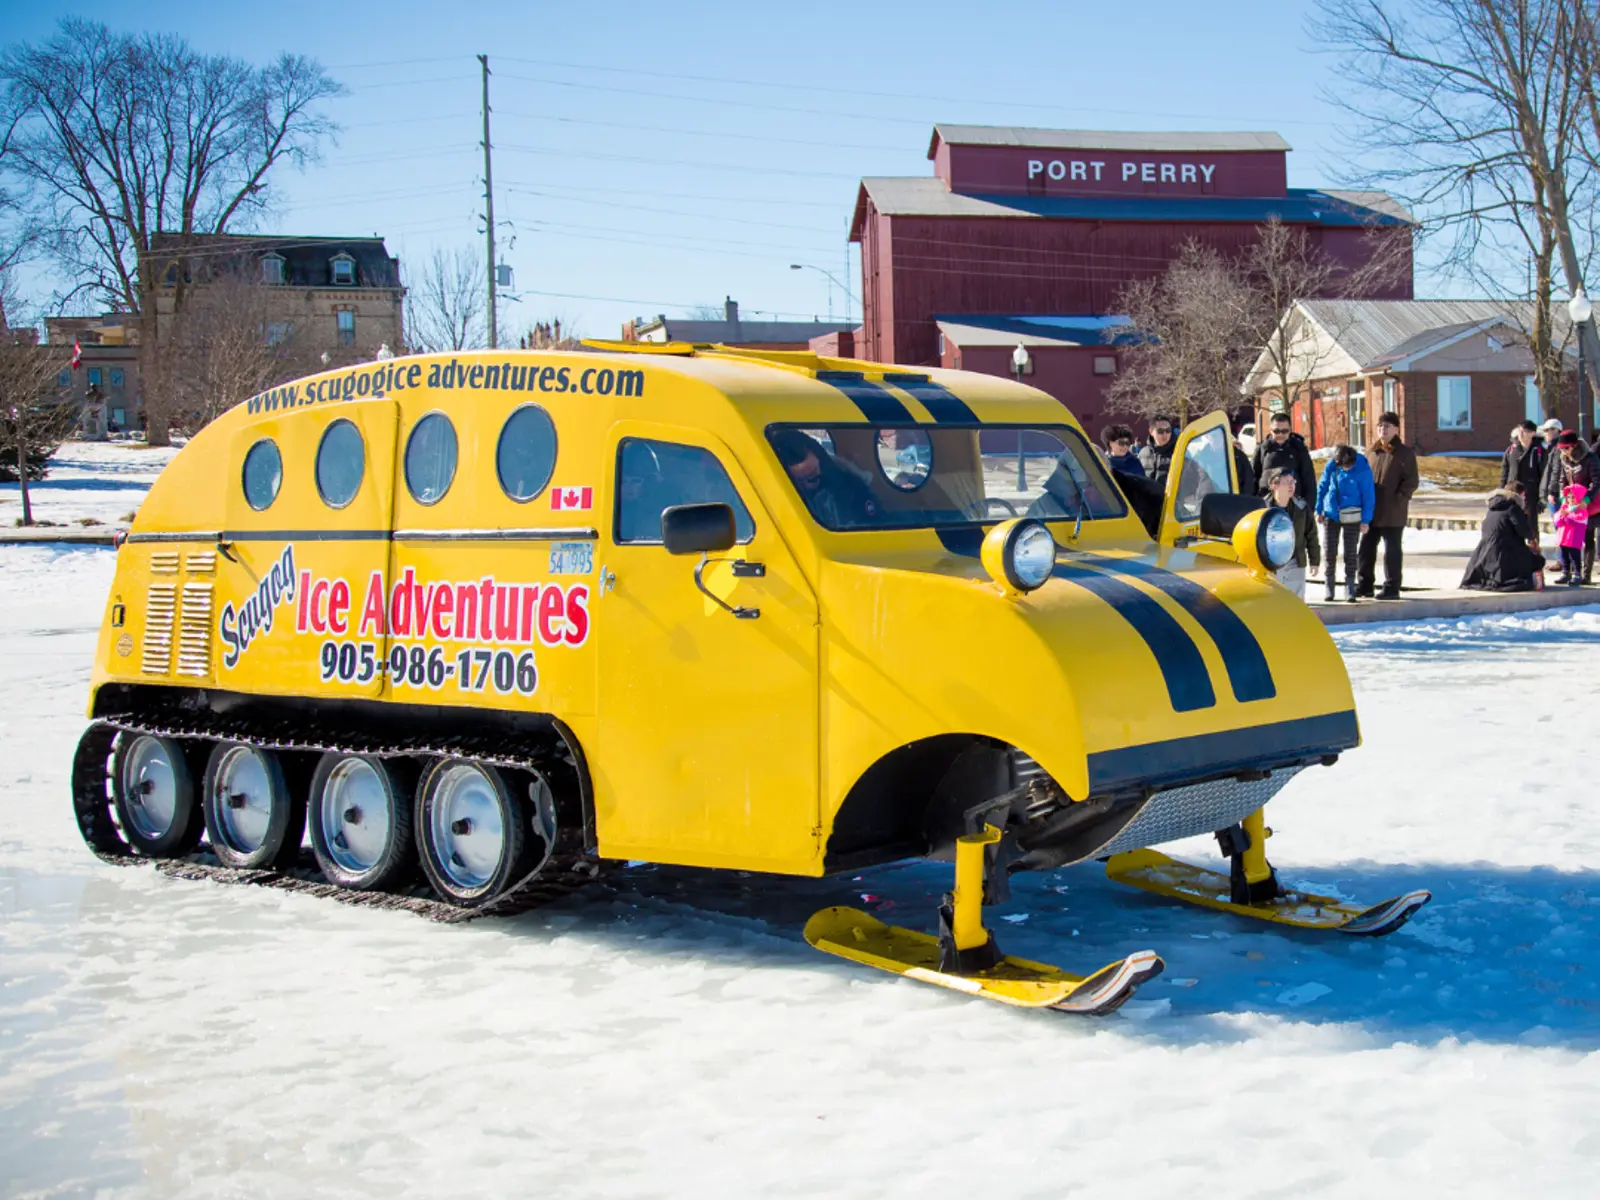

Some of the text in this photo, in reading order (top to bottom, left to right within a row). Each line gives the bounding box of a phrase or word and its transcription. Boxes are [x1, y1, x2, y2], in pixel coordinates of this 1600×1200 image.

[1027, 159, 1216, 183] PORT PERRY
[427, 359, 644, 397] adventures.com
[221, 545, 589, 667] Scugog Ice Adventures
[322, 642, 536, 693] 905-986-1706
